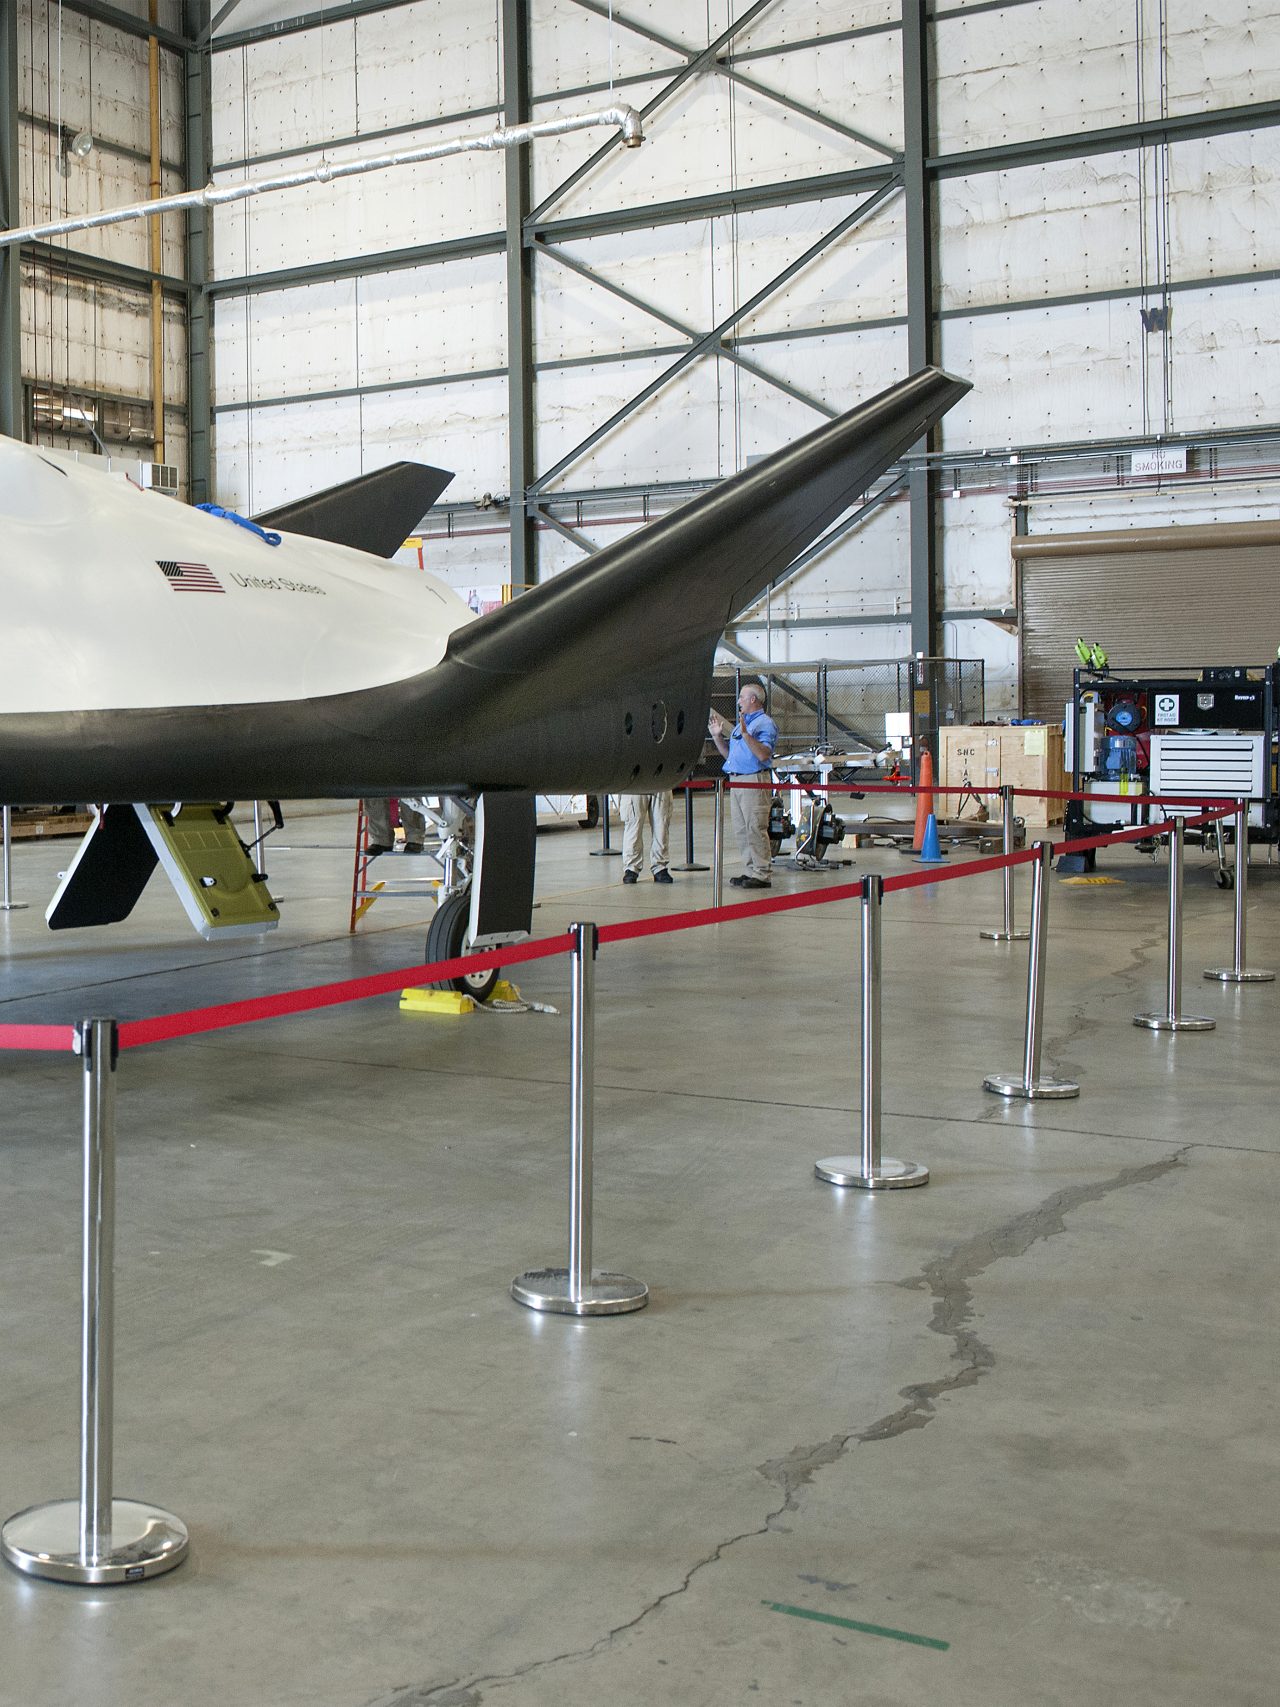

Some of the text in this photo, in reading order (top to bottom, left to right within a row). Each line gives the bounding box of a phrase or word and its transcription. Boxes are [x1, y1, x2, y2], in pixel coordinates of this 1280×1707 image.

[1135, 460, 1183, 472] SMOKING
[229, 572, 327, 595] United States
